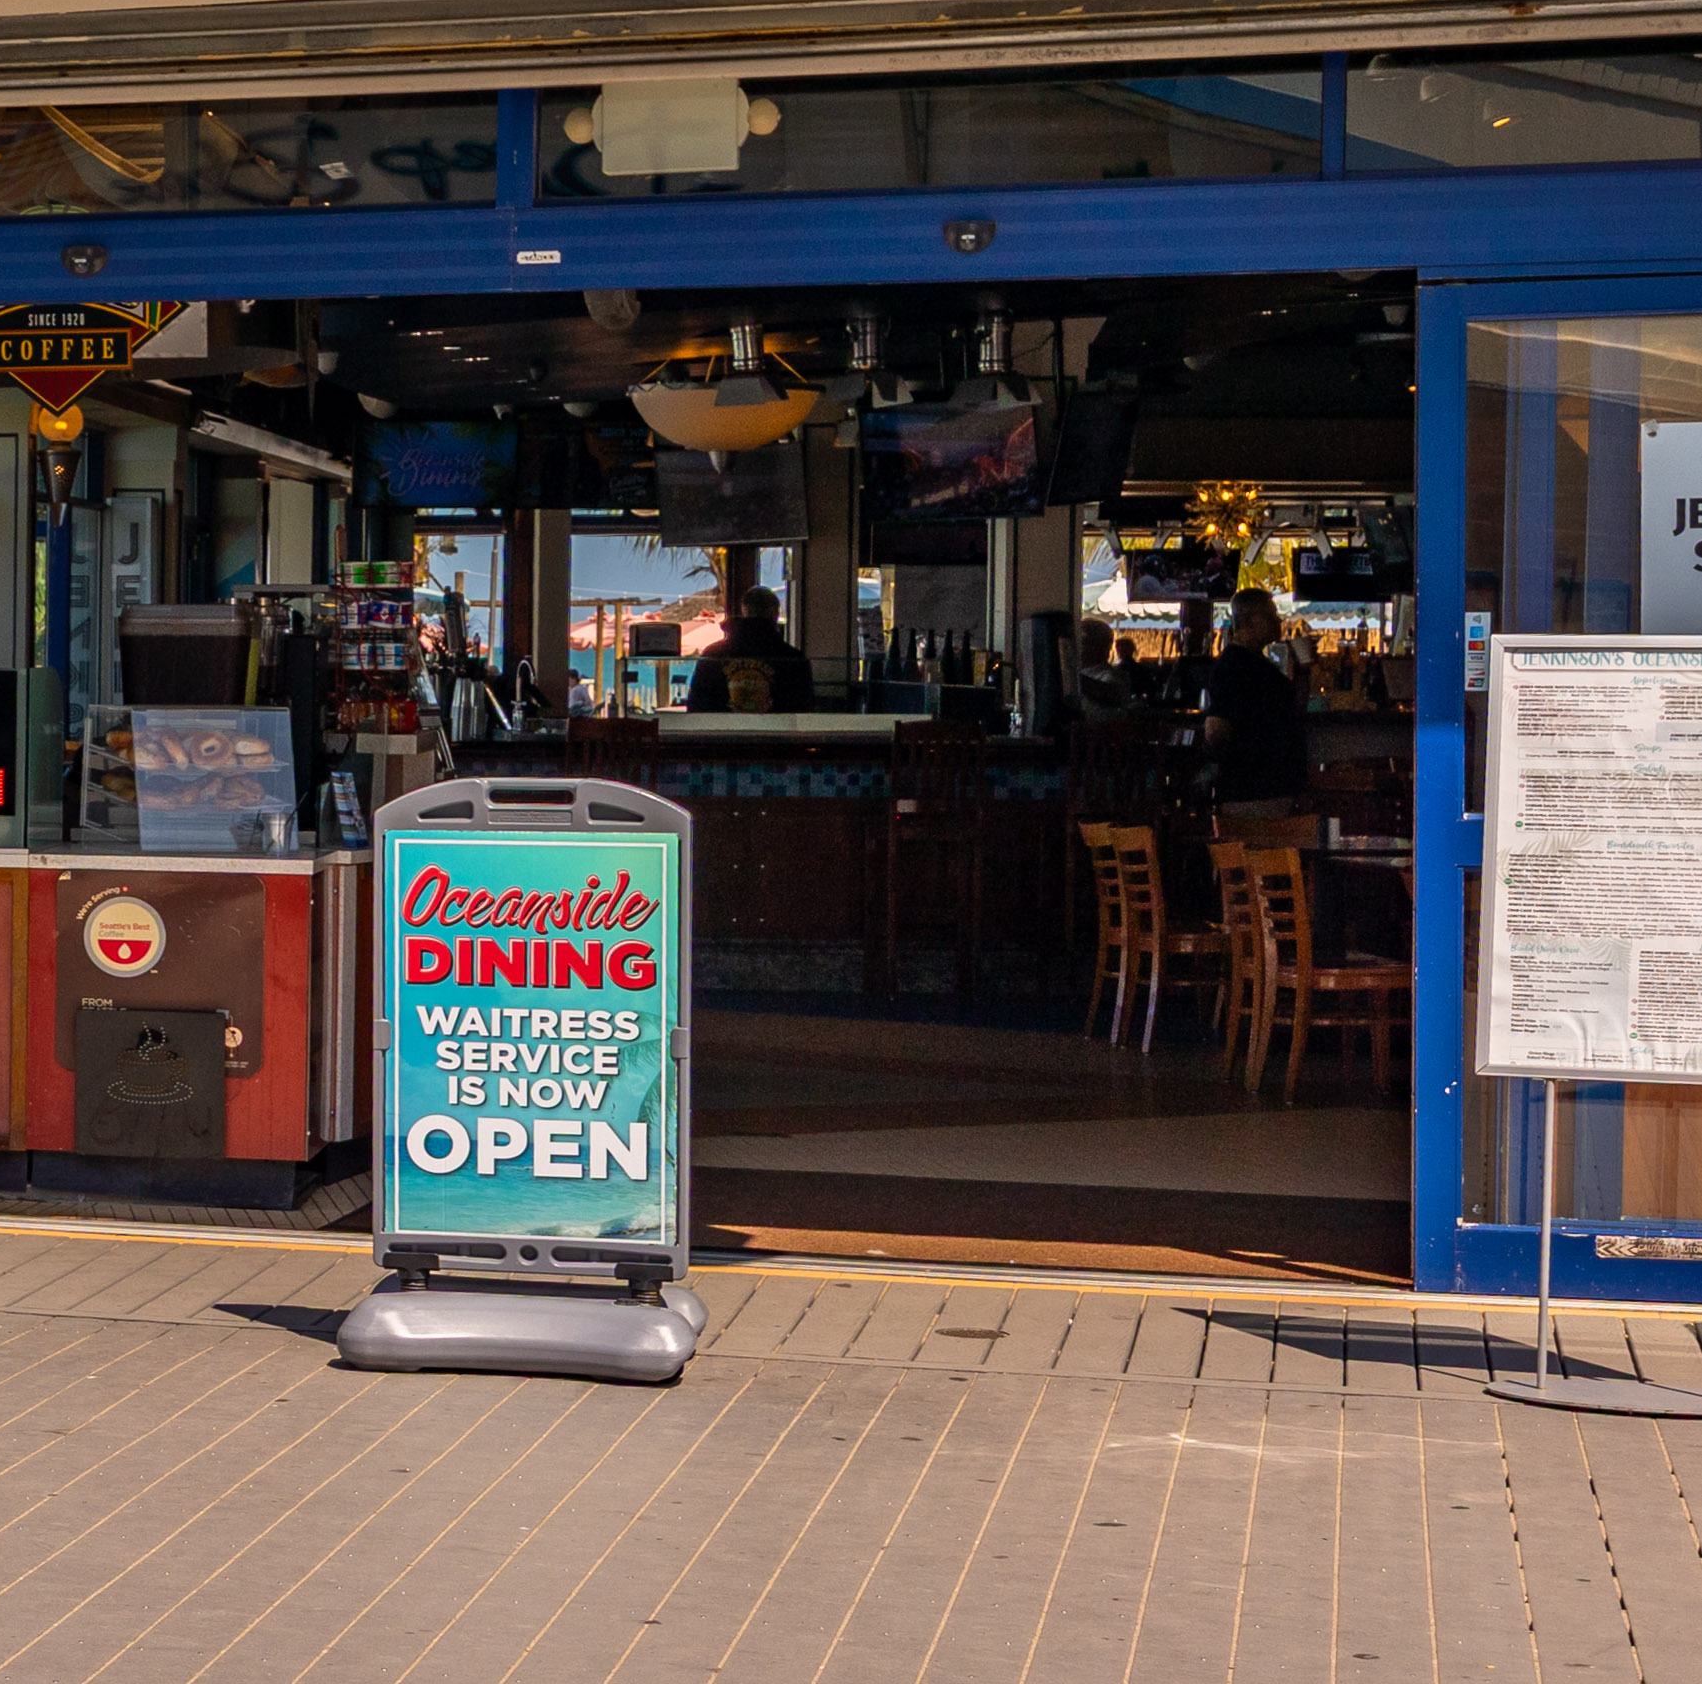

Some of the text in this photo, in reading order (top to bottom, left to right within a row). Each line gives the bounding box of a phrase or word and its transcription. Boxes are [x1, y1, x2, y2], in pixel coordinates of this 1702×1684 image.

[28, 312, 86, 327] SINCE 1920
[0, 337, 115, 362] COFFEE
[1520, 652, 1625, 667] JENKINSON'S
[400, 862, 661, 934] Oceanside
[98, 930, 125, 938] Coffee
[99, 922, 150, 931] Seattle's Best
[402, 933, 658, 990] DINING
[81, 997, 113, 1007] FROM
[416, 1004, 641, 1043] WAITRESS
[435, 1040, 621, 1077] SERVICE
[448, 1073, 609, 1111] IS NOW
[404, 1113, 649, 1182] OPEN
